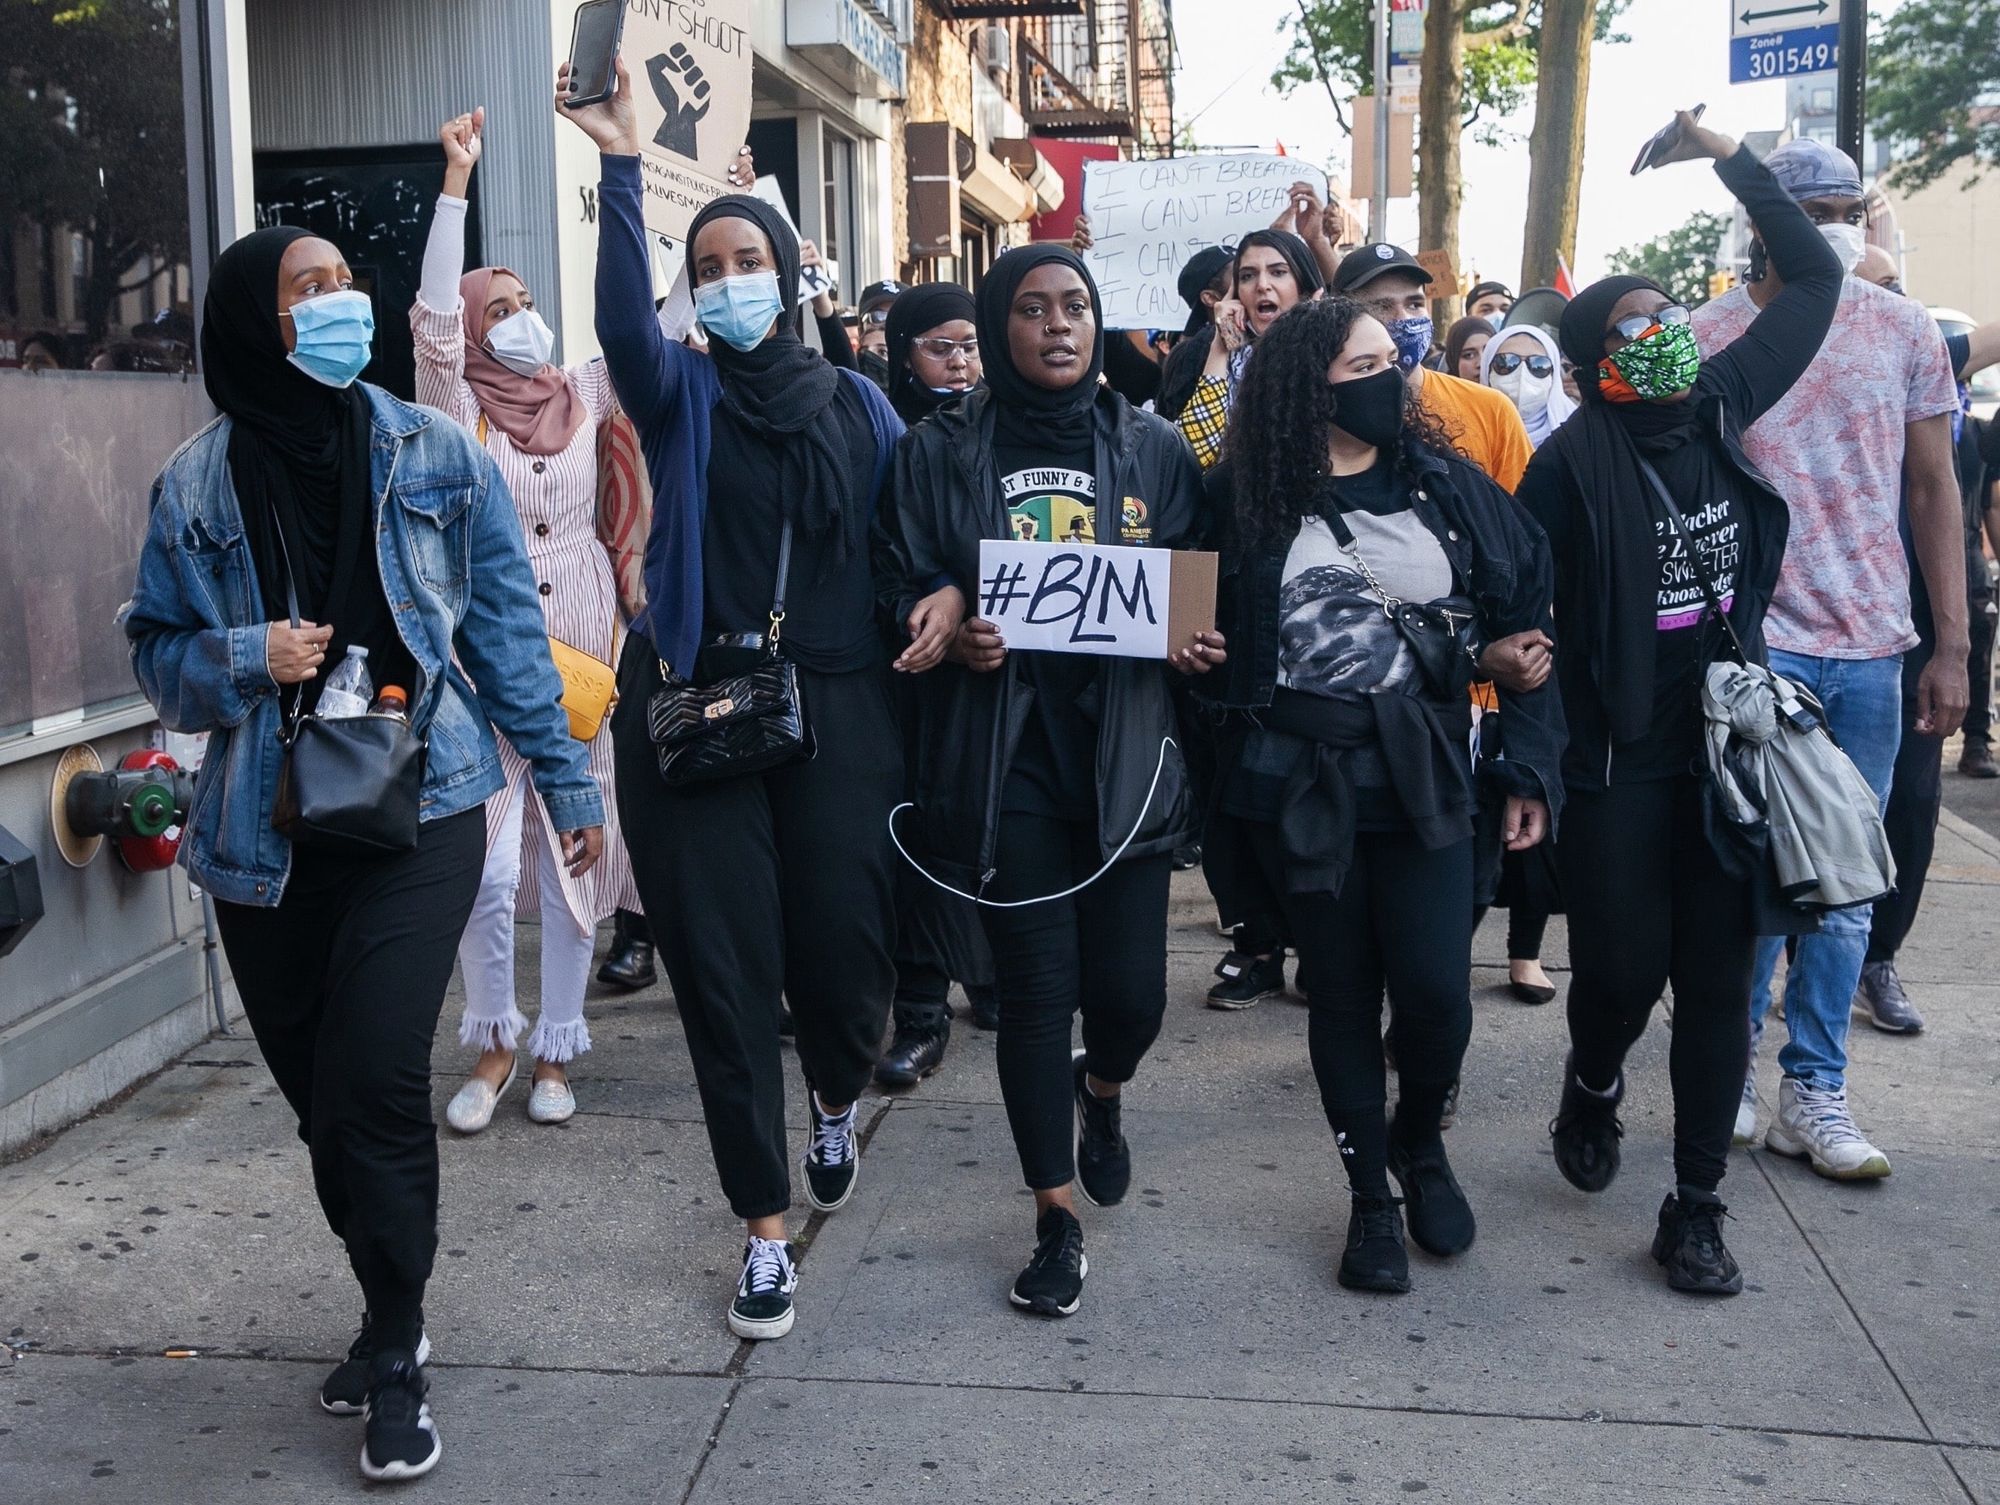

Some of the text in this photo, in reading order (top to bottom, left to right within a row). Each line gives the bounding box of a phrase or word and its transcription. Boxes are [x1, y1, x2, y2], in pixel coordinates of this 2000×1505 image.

[1750, 43, 1828, 78] 301549
[580, 185, 599, 223] 58
[1022, 471, 1070, 487] FUNNY
[1073, 477, 1083, 487] &
[1669, 500, 1730, 535] acker
[979, 553, 1158, 643] #BLM
